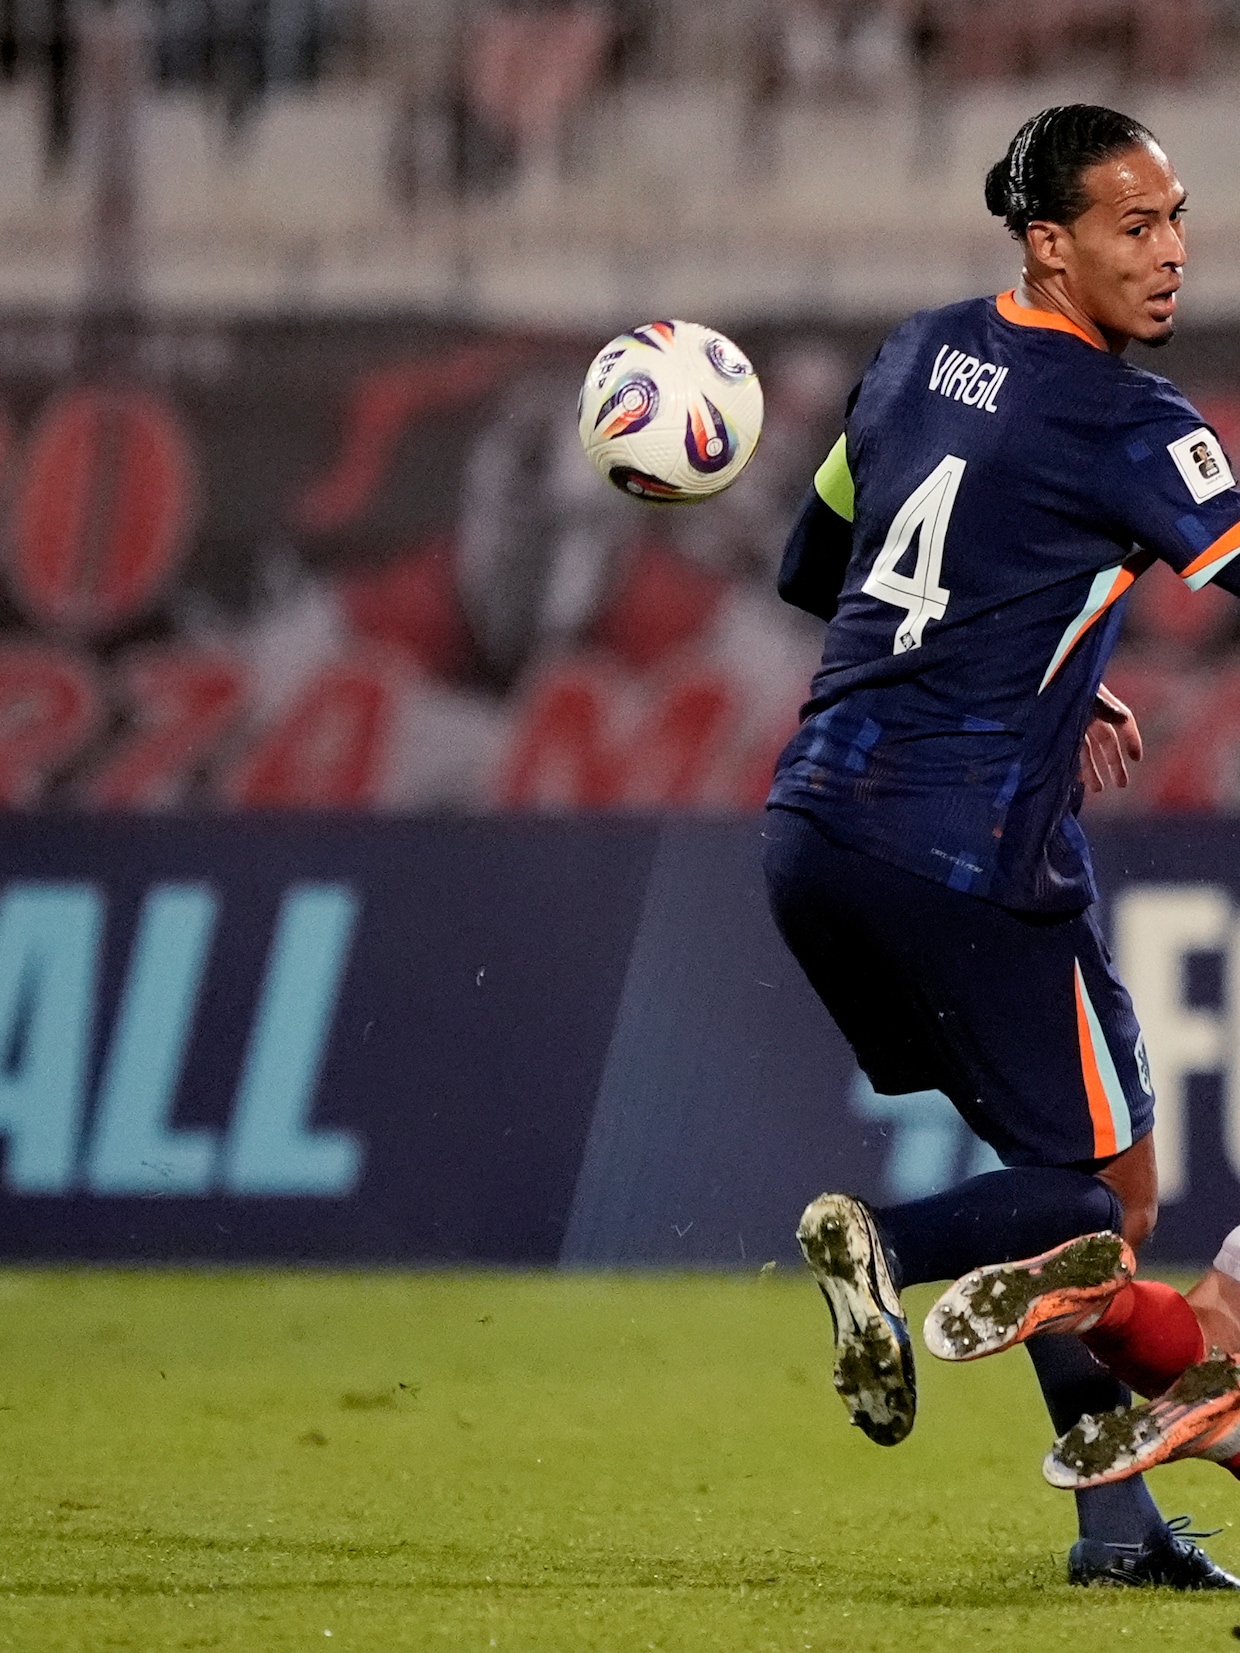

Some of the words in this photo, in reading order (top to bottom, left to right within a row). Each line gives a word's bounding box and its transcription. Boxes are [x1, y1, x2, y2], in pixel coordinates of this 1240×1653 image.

[928, 344, 1009, 413] VIRGIL
[861, 454, 967, 655] 4
[0, 882, 362, 1198] ALL
